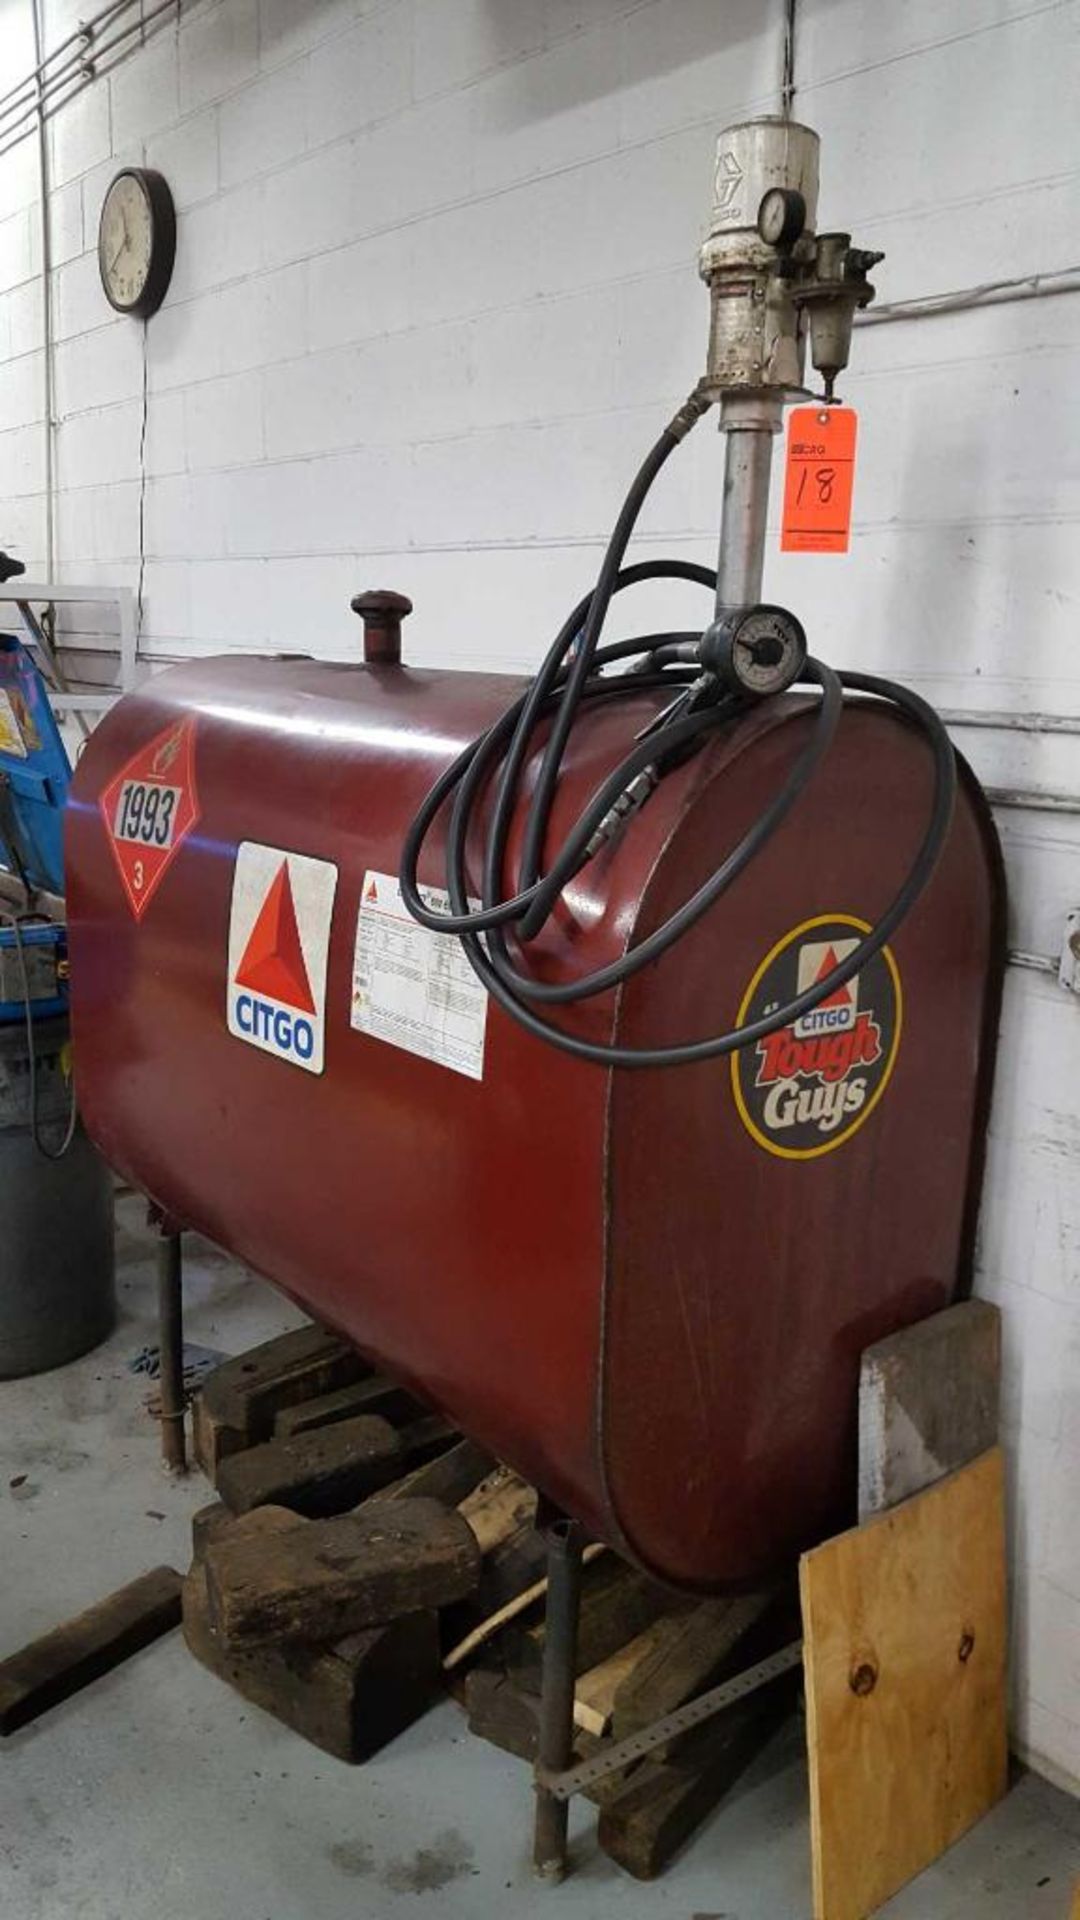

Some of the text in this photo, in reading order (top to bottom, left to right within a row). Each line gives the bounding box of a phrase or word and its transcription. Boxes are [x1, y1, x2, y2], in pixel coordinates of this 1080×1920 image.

[796, 467, 836, 506] 18
[119, 784, 175, 846] 1993
[133, 860, 144, 889] 3
[235, 994, 314, 1060] CITGO
[801, 1007, 850, 1031] CITGO
[757, 1012, 880, 1084] Tough
[764, 1078, 867, 1131] Guys
